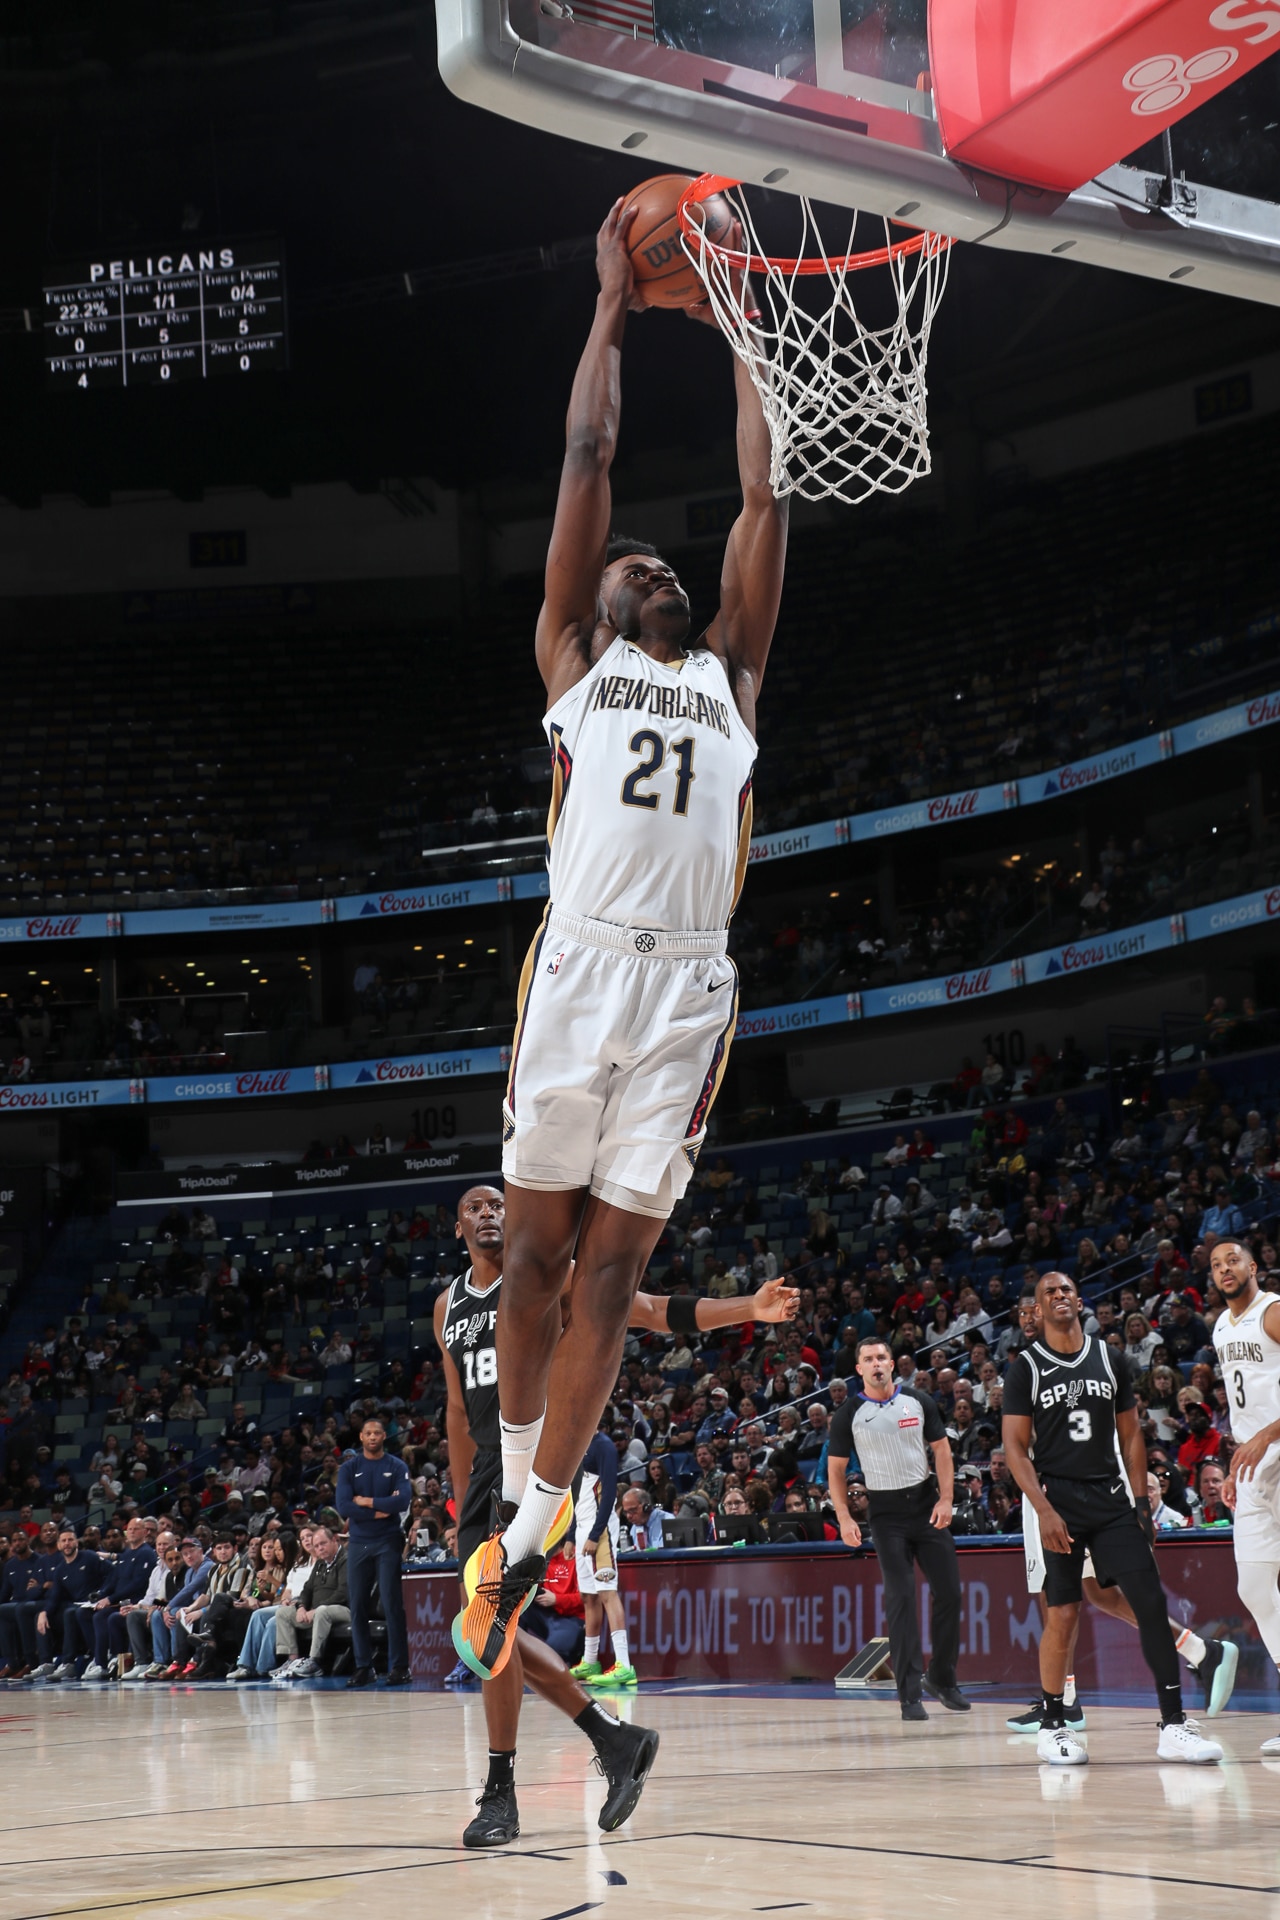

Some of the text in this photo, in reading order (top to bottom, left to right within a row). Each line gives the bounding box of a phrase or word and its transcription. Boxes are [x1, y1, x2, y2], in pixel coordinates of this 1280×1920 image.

[90, 249, 235, 282] PELICANS
[153, 293, 175, 310] 1/1
[230, 285, 255, 301] 0/4
[59, 302, 108, 320] 22.2%
[159, 329, 169, 344] 5
[239, 319, 249, 335] 5
[75, 338, 85, 353] 0
[160, 364, 170, 380] 0
[240, 355, 250, 371] 0
[77, 373, 88, 388] 4
[593, 675, 731, 740] NEW ORLEANS
[619, 727, 695, 817] 21
[1058, 752, 1137, 790] Coors LIGHT
[875, 811, 925, 832] CHOOSE
[927, 791, 979, 822] Chill
[771, 835, 810, 856] LIGHT
[379, 890, 471, 913] Coors LIGHT
[1210, 903, 1262, 929] CHOOSE
[26, 917, 81, 938] Chill
[1062, 934, 1146, 971] Coors LIGHT
[889, 987, 942, 1008] CHOOSE
[945, 968, 993, 1001] Chill
[778, 1009, 820, 1030] LIGHT
[375, 1059, 472, 1081] Coors LIGHT
[175, 1082, 232, 1096] CHOOSE
[236, 1071, 292, 1094] Chill
[51, 1089, 100, 1105] LIGHT
[412, 1105, 456, 1140] 109
[295, 1166, 343, 1182] TripADeal
[404, 1156, 452, 1171] TripADeal
[178, 1176, 230, 1191] TripADeal
[1226, 1341, 1264, 1363] ORLEANS
[463, 1346, 498, 1390] 18
[1040, 1379, 1113, 1409] SPURS
[1234, 1369, 1246, 1409] 3
[1068, 1409, 1092, 1442] 3
[748, 1597, 774, 1646] TO
[782, 1595, 824, 1645] THE
